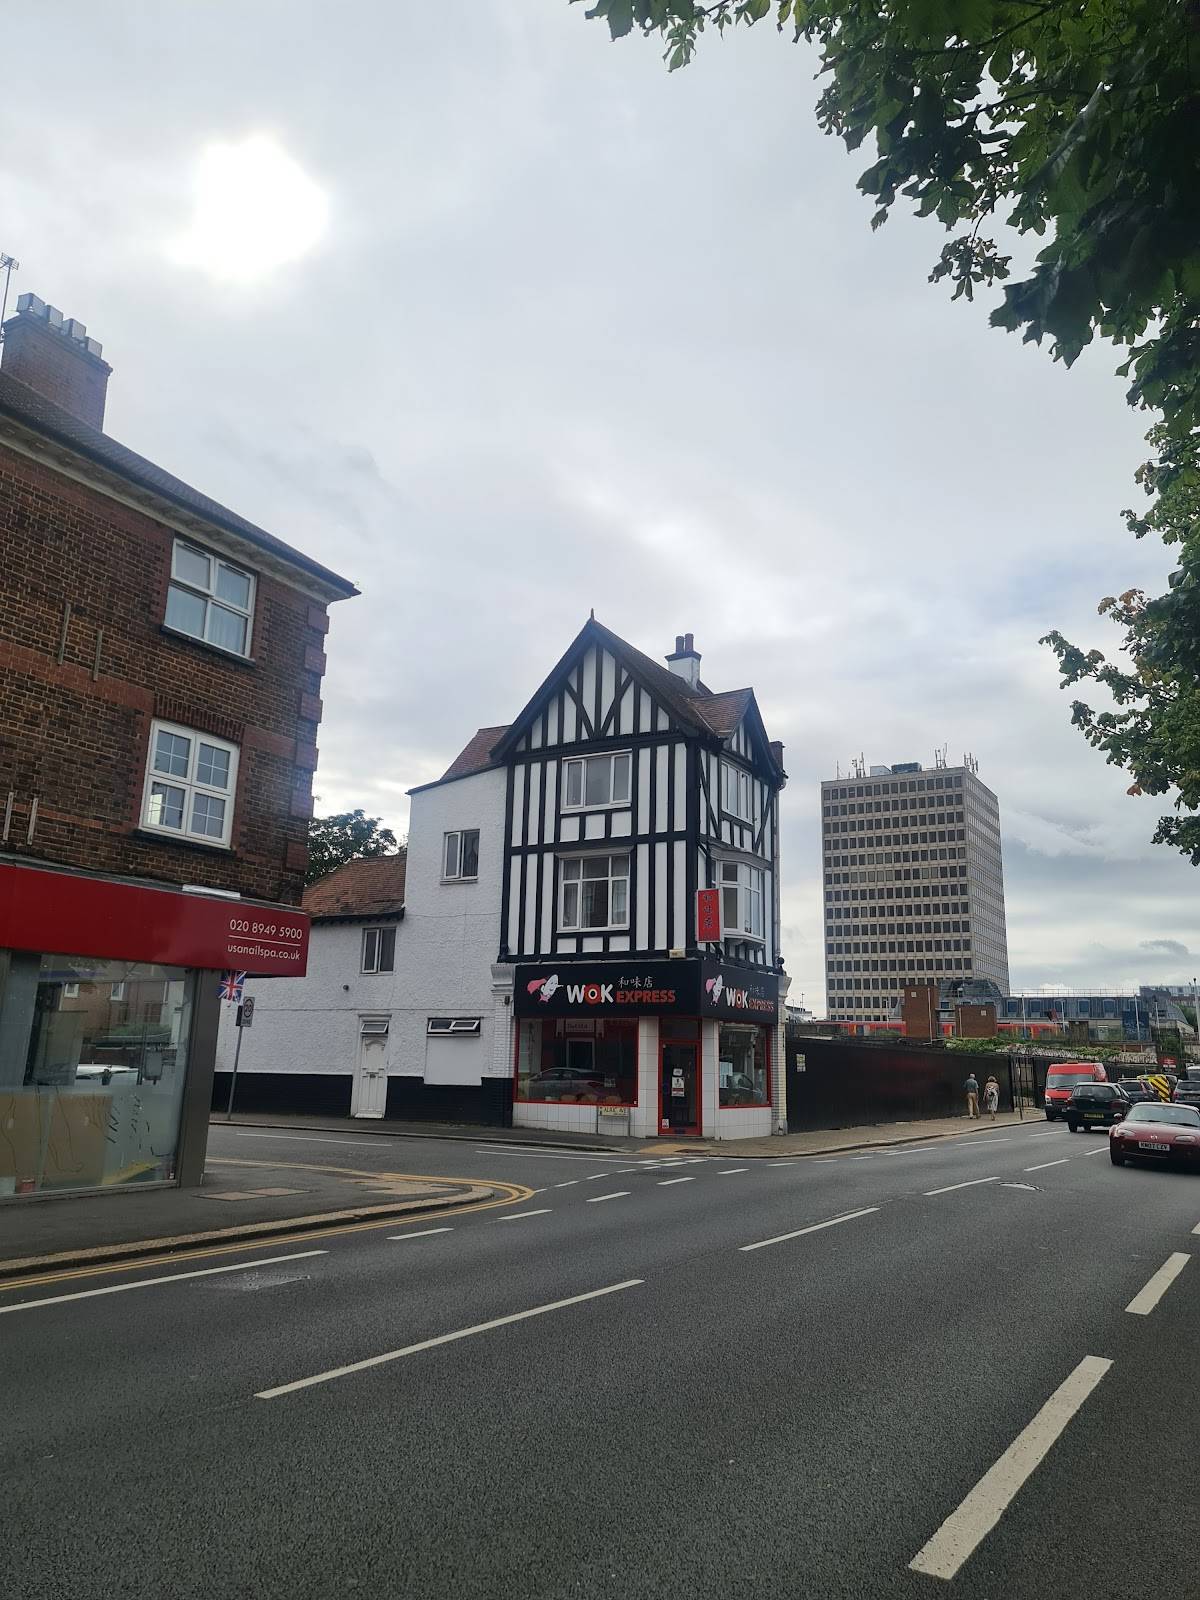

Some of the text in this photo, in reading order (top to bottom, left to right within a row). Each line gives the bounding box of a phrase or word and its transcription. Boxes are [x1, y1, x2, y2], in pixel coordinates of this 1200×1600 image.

[229, 919, 303, 939] 020 8949 5900
[227, 944, 300, 961] usanailspa.co.uk
[617, 976, 655, 989] 和味店
[566, 983, 676, 1005] WOK EXPRESS
[726, 987, 748, 1009] WOK
